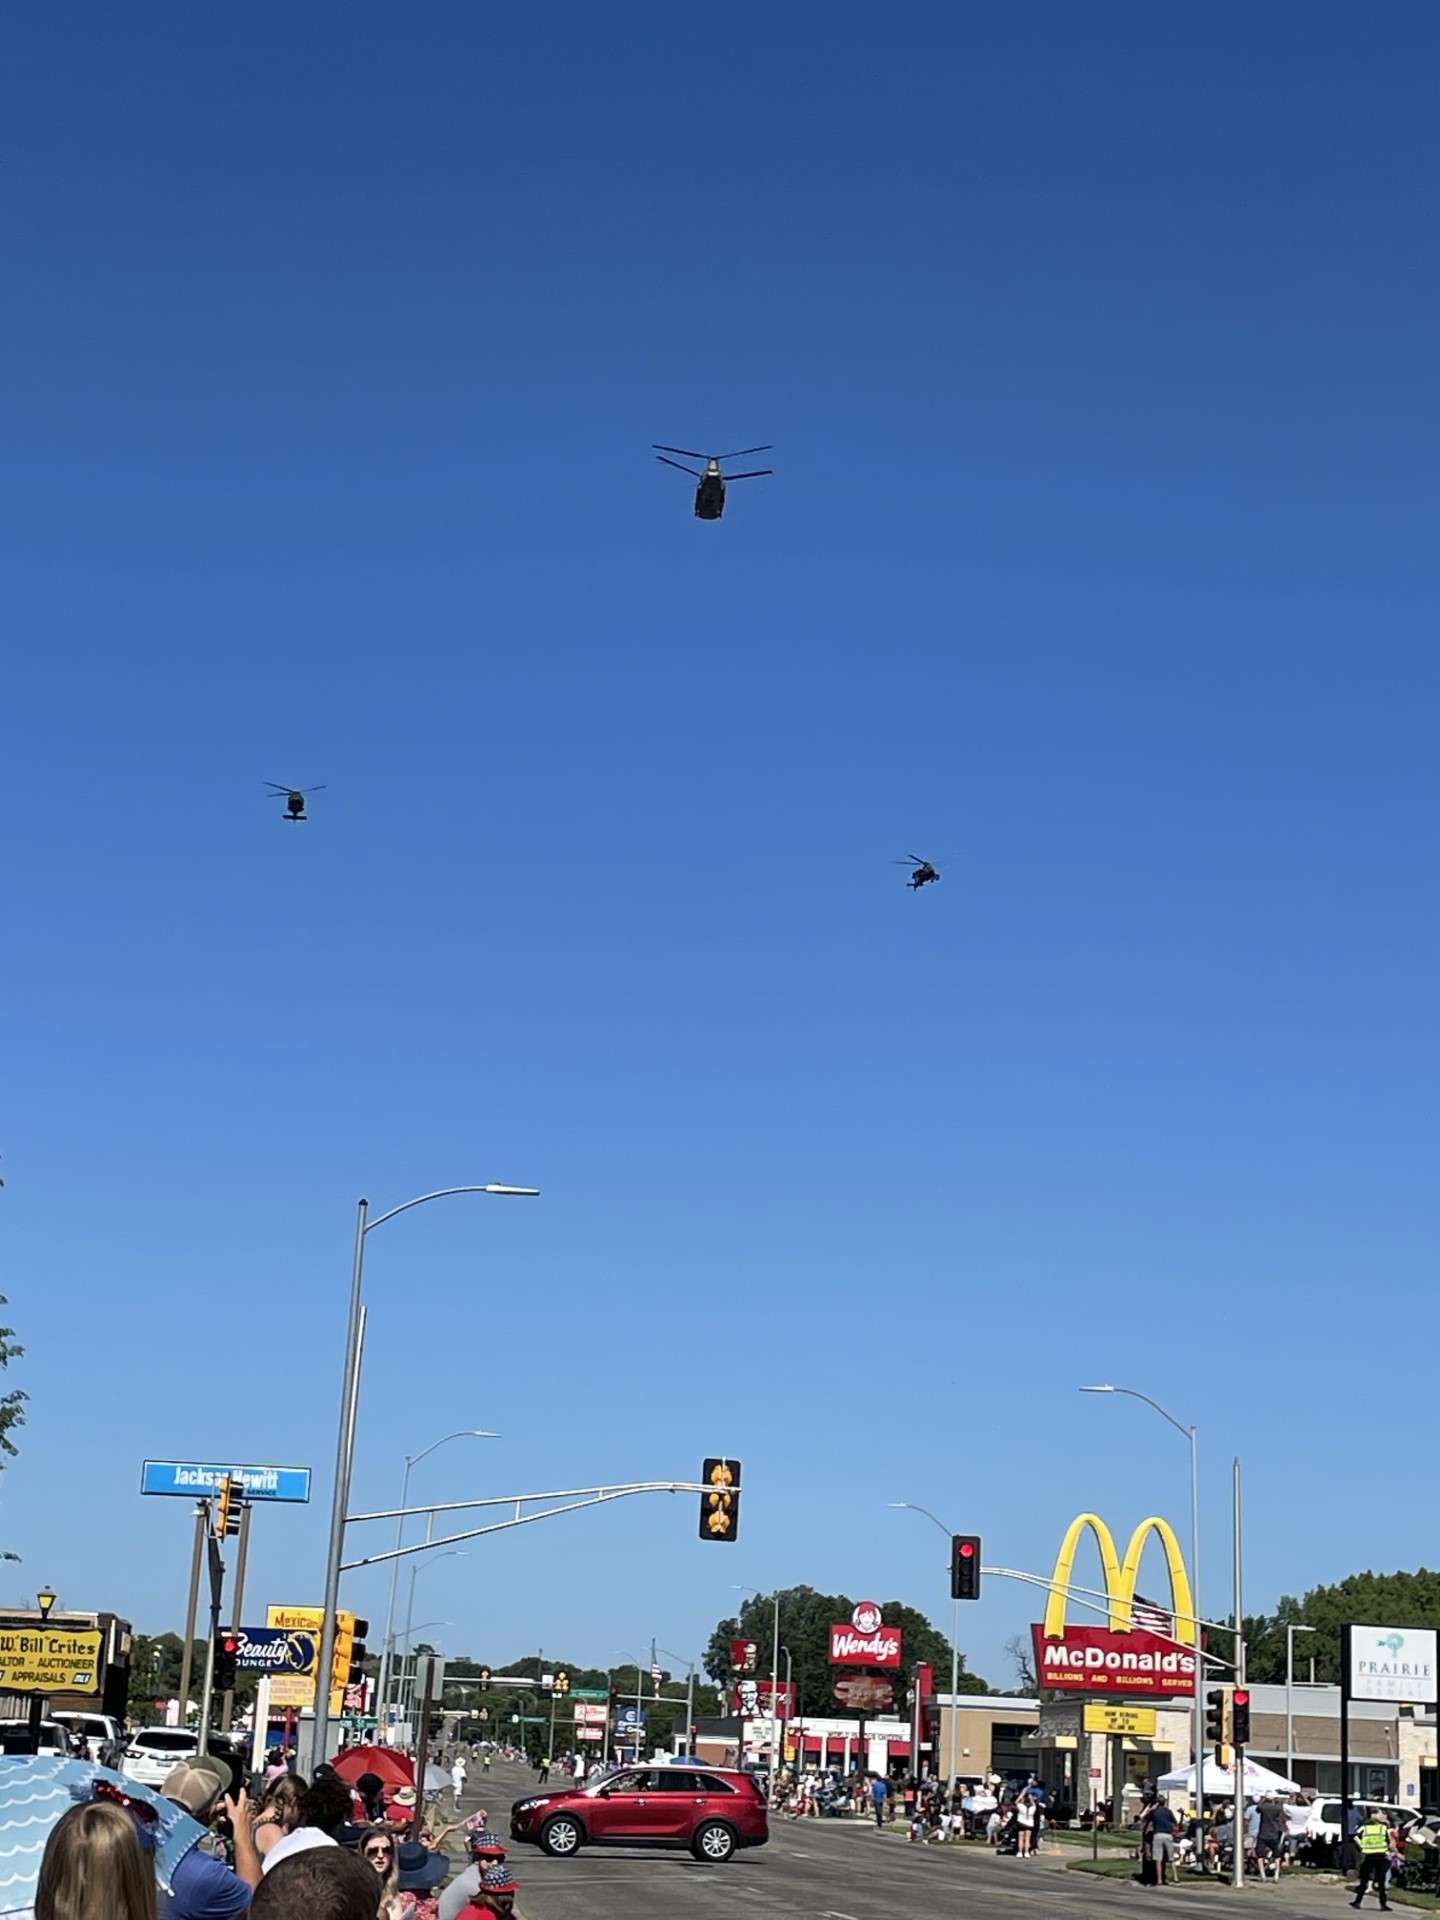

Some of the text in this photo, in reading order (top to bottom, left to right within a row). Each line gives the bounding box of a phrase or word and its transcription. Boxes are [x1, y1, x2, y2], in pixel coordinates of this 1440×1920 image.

[232, 1469, 279, 1489] Hewitt
[49, 1638, 96, 1655] Crites
[221, 1631, 288, 1665] Beauty
[832, 1632, 899, 1662] Wendy's
[37, 1657, 95, 1670] AUCTIONEER
[1043, 1645, 1196, 1673] McDonald's
[1358, 1660, 1431, 1676] PRAIRIE
[11, 1670, 66, 1684] APPRAISALS
[1046, 1672, 1194, 1688] BILLIONS AND BILLIONS SERVED
